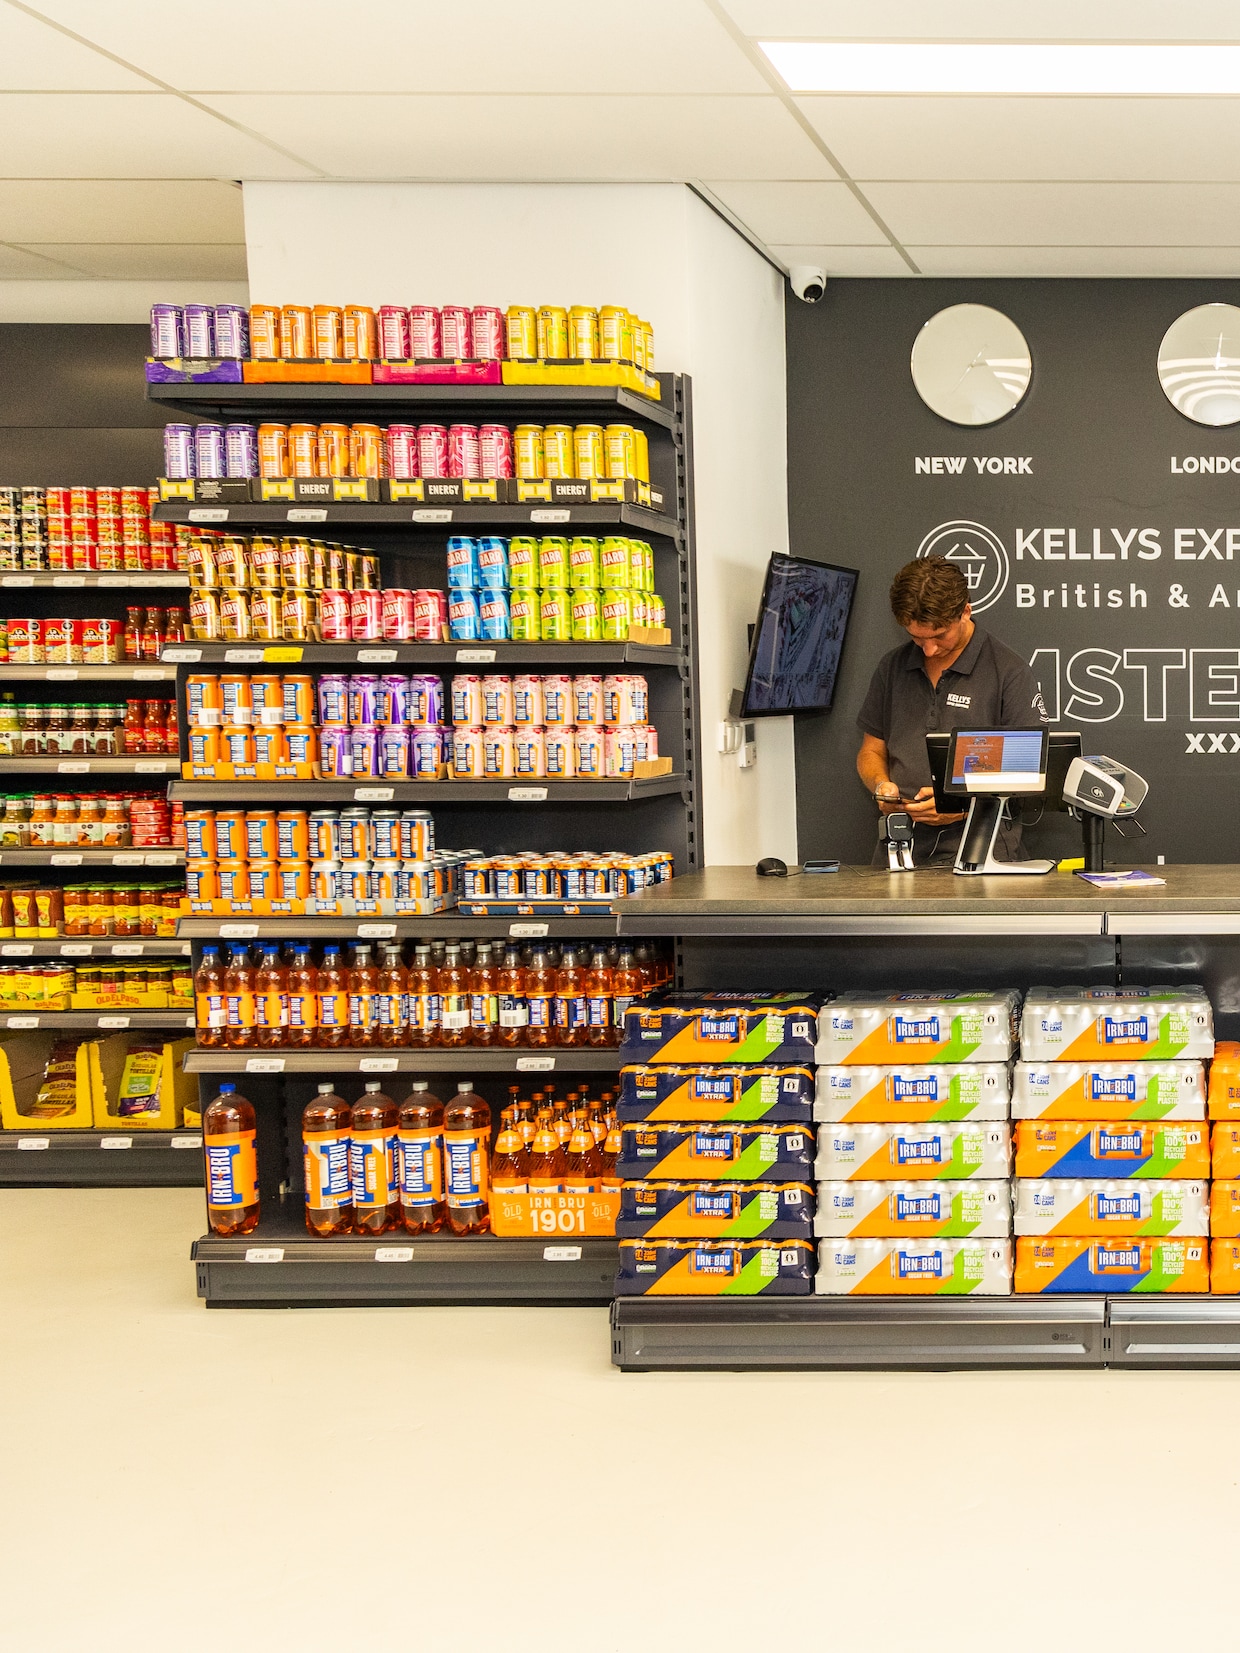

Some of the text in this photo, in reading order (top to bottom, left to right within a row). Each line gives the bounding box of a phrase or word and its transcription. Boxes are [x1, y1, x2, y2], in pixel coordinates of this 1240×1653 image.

[914, 457, 1033, 475] NEW YORK
[299, 484, 330, 495] ENERGY
[428, 484, 459, 496] ENERGY
[556, 484, 587, 496] ENERGY
[1015, 528, 1162, 561] KELLYS
[254, 551, 280, 565] BARR
[602, 550, 625, 565] BARR
[1016, 584, 1148, 609] British
[1169, 584, 1191, 609] &
[573, 603, 597, 618] BARR
[603, 602, 627, 617] BARR
[947, 693, 971, 704] KELLYS
[96, 995, 110, 1005] OLD
[529, 1197, 586, 1209] IRN BRU
[504, 1204, 522, 1217] OLD
[593, 1204, 610, 1217] OLD
[529, 1209, 586, 1233] 1901
